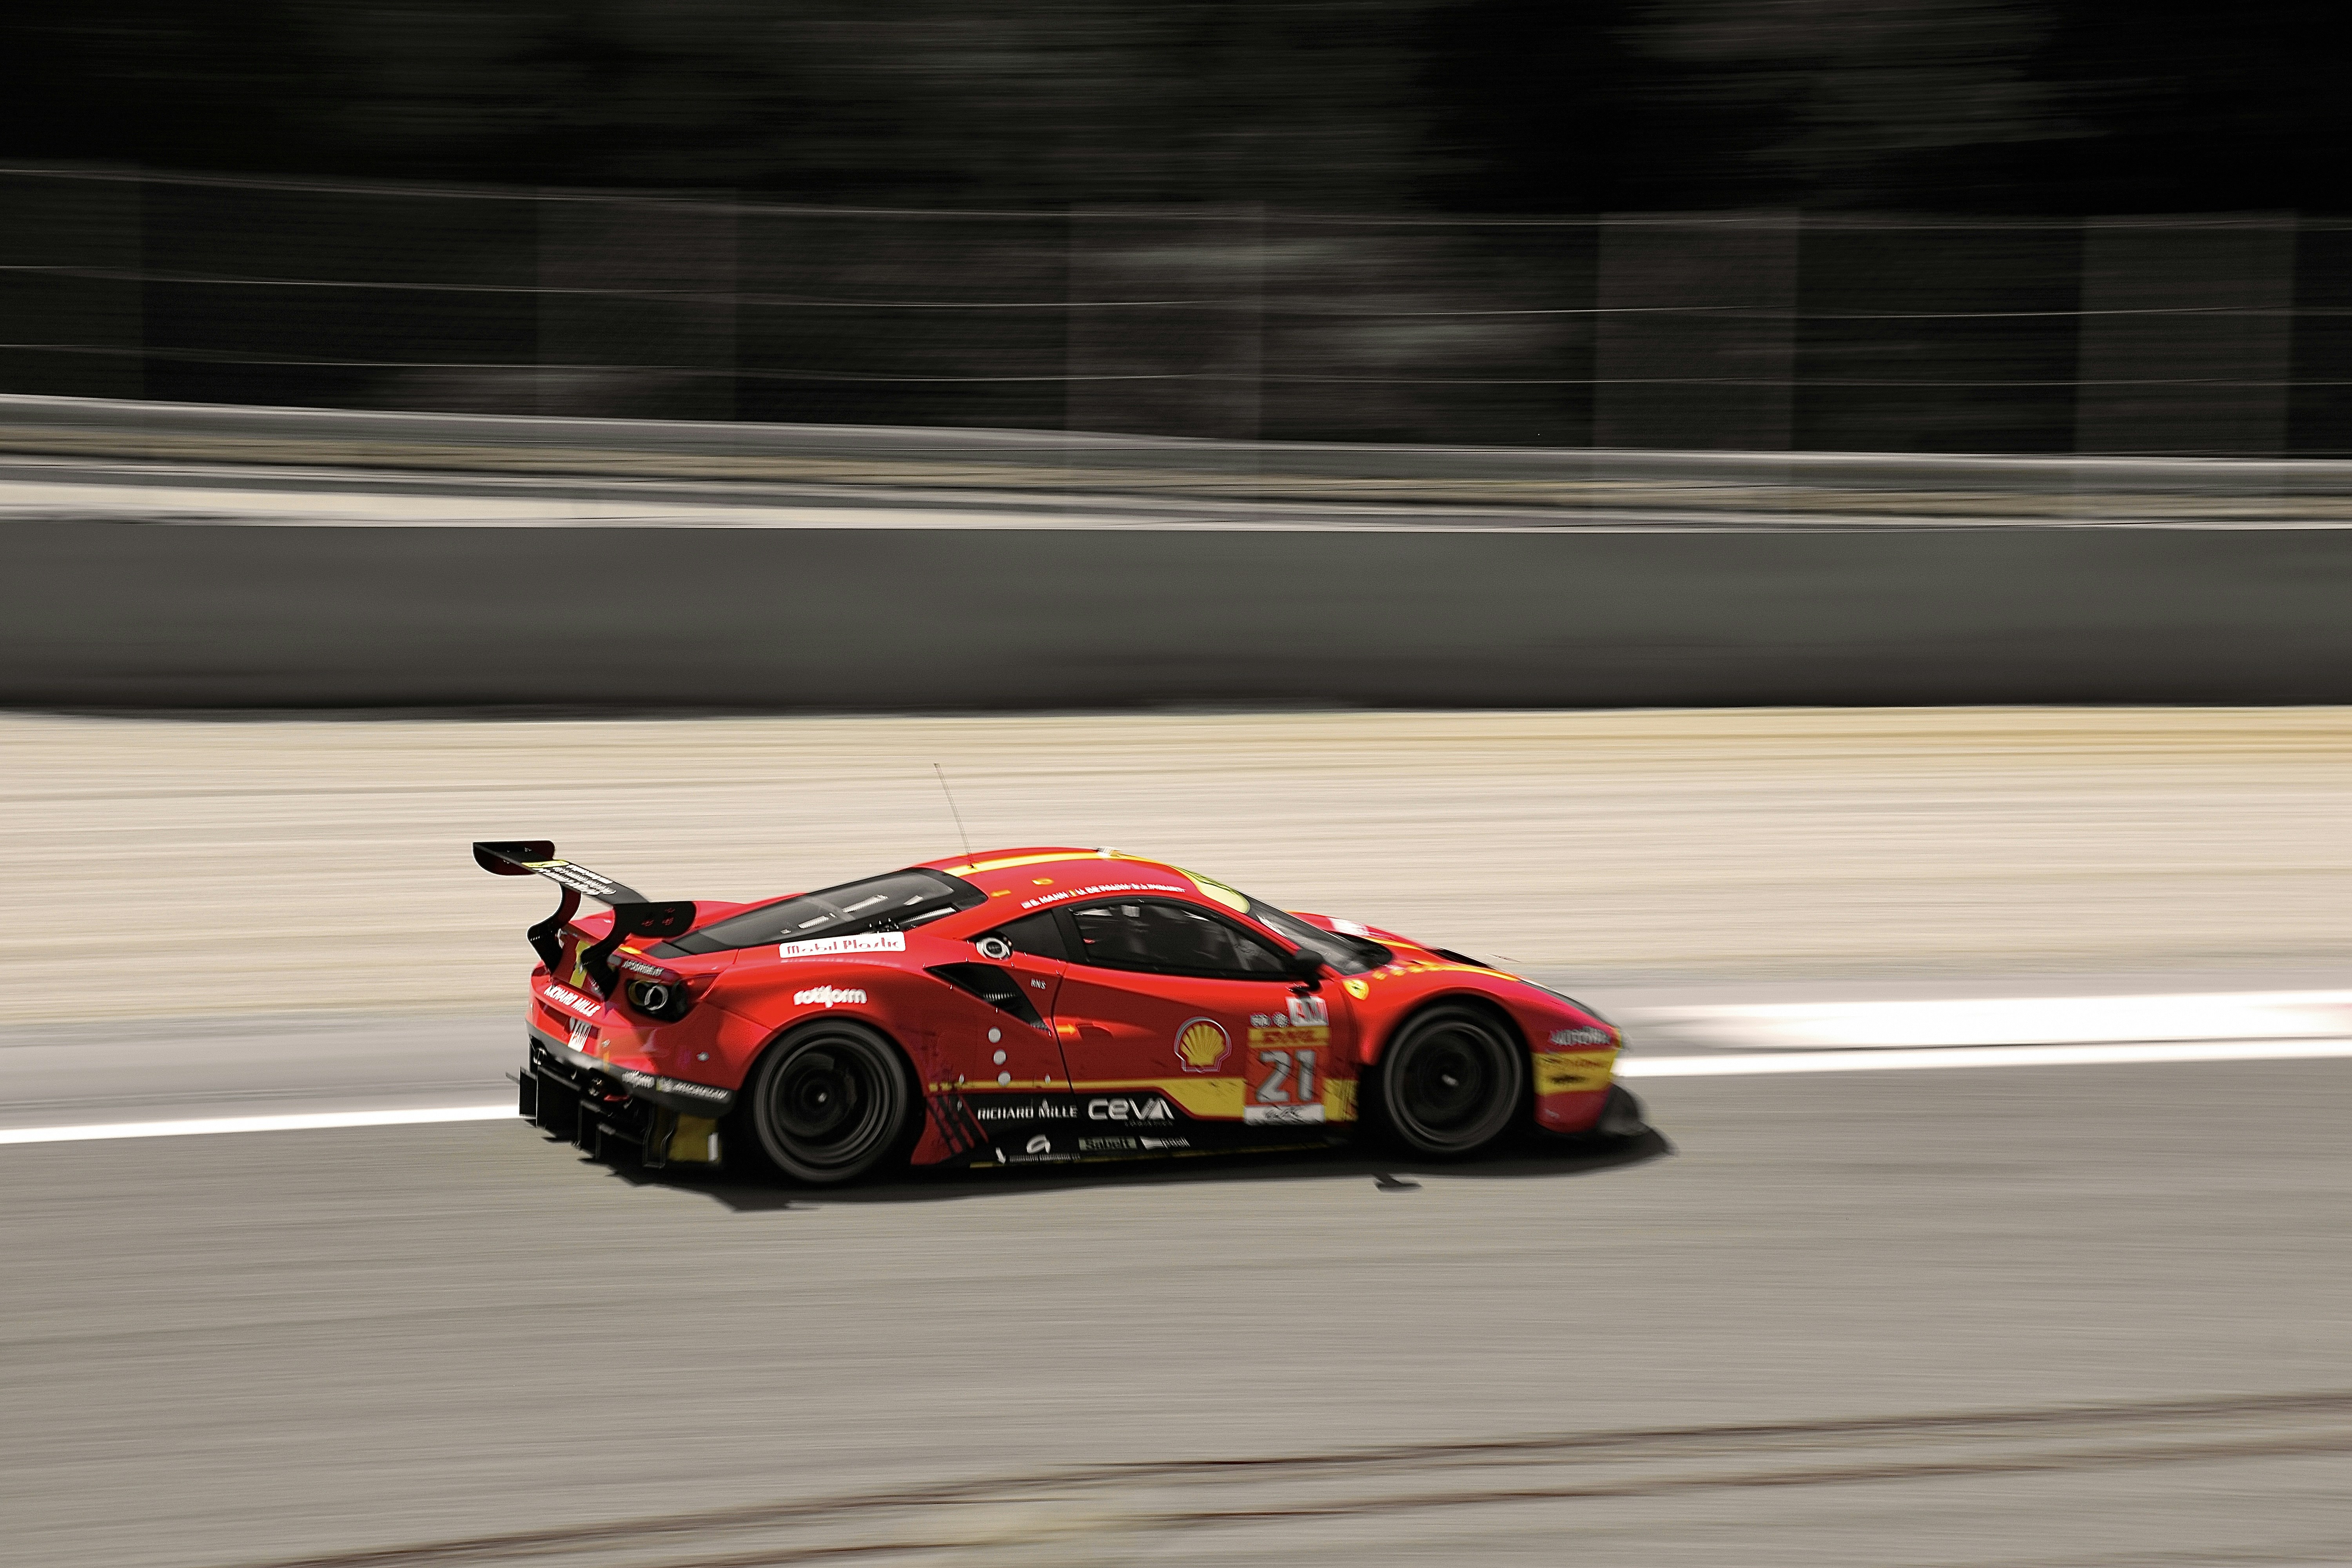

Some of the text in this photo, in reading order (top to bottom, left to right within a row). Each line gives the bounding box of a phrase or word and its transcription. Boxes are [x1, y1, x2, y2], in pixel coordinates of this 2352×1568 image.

[1038, 891, 1069, 904] MANN
[793, 984, 867, 1008] rotiform
[1257, 1050, 1315, 1102] 21
[978, 1103, 1078, 1120] RICHARD MILLE
